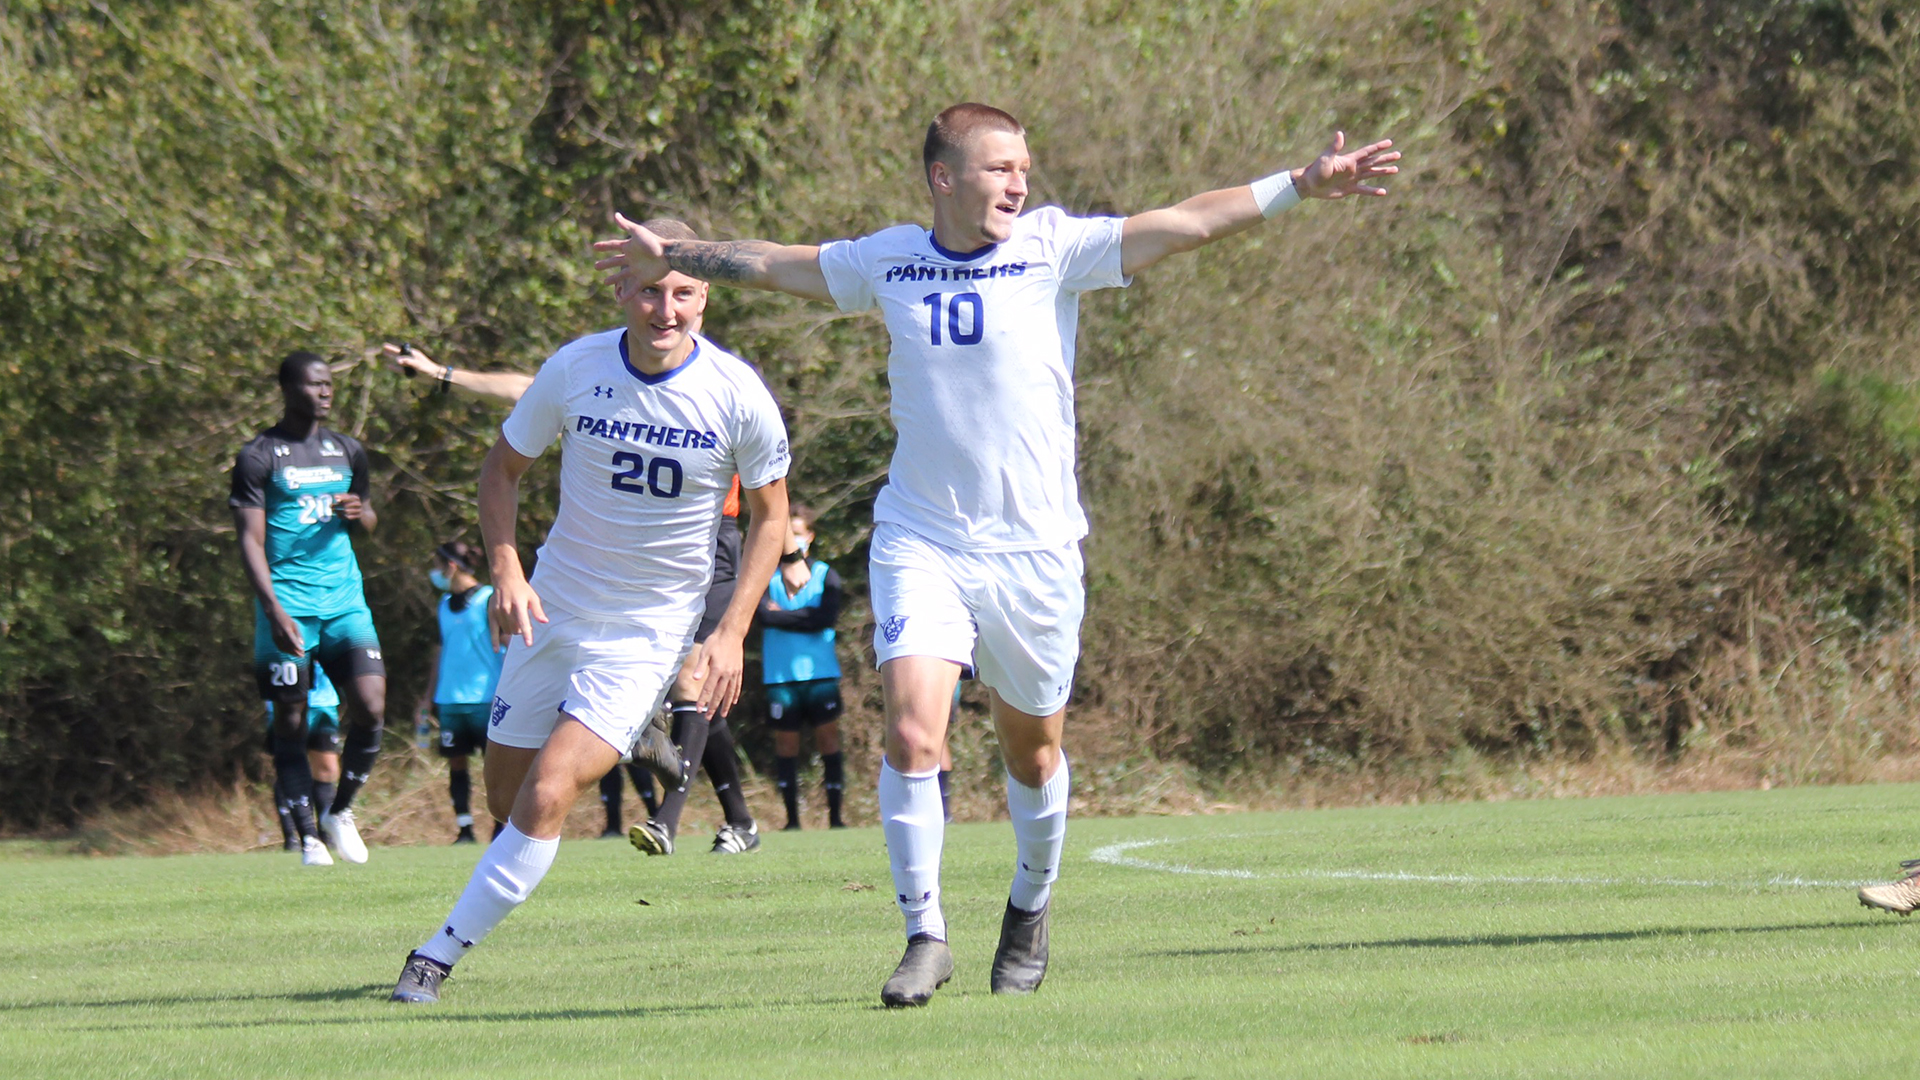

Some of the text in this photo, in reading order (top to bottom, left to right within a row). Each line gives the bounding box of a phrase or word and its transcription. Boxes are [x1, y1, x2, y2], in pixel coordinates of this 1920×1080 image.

[886, 261, 1028, 282] PANTHERS
[923, 292, 984, 346] 10
[576, 415, 718, 449] PANTHERS
[611, 450, 683, 499] 20
[297, 493, 333, 524] 20
[269, 661, 298, 687] 20
